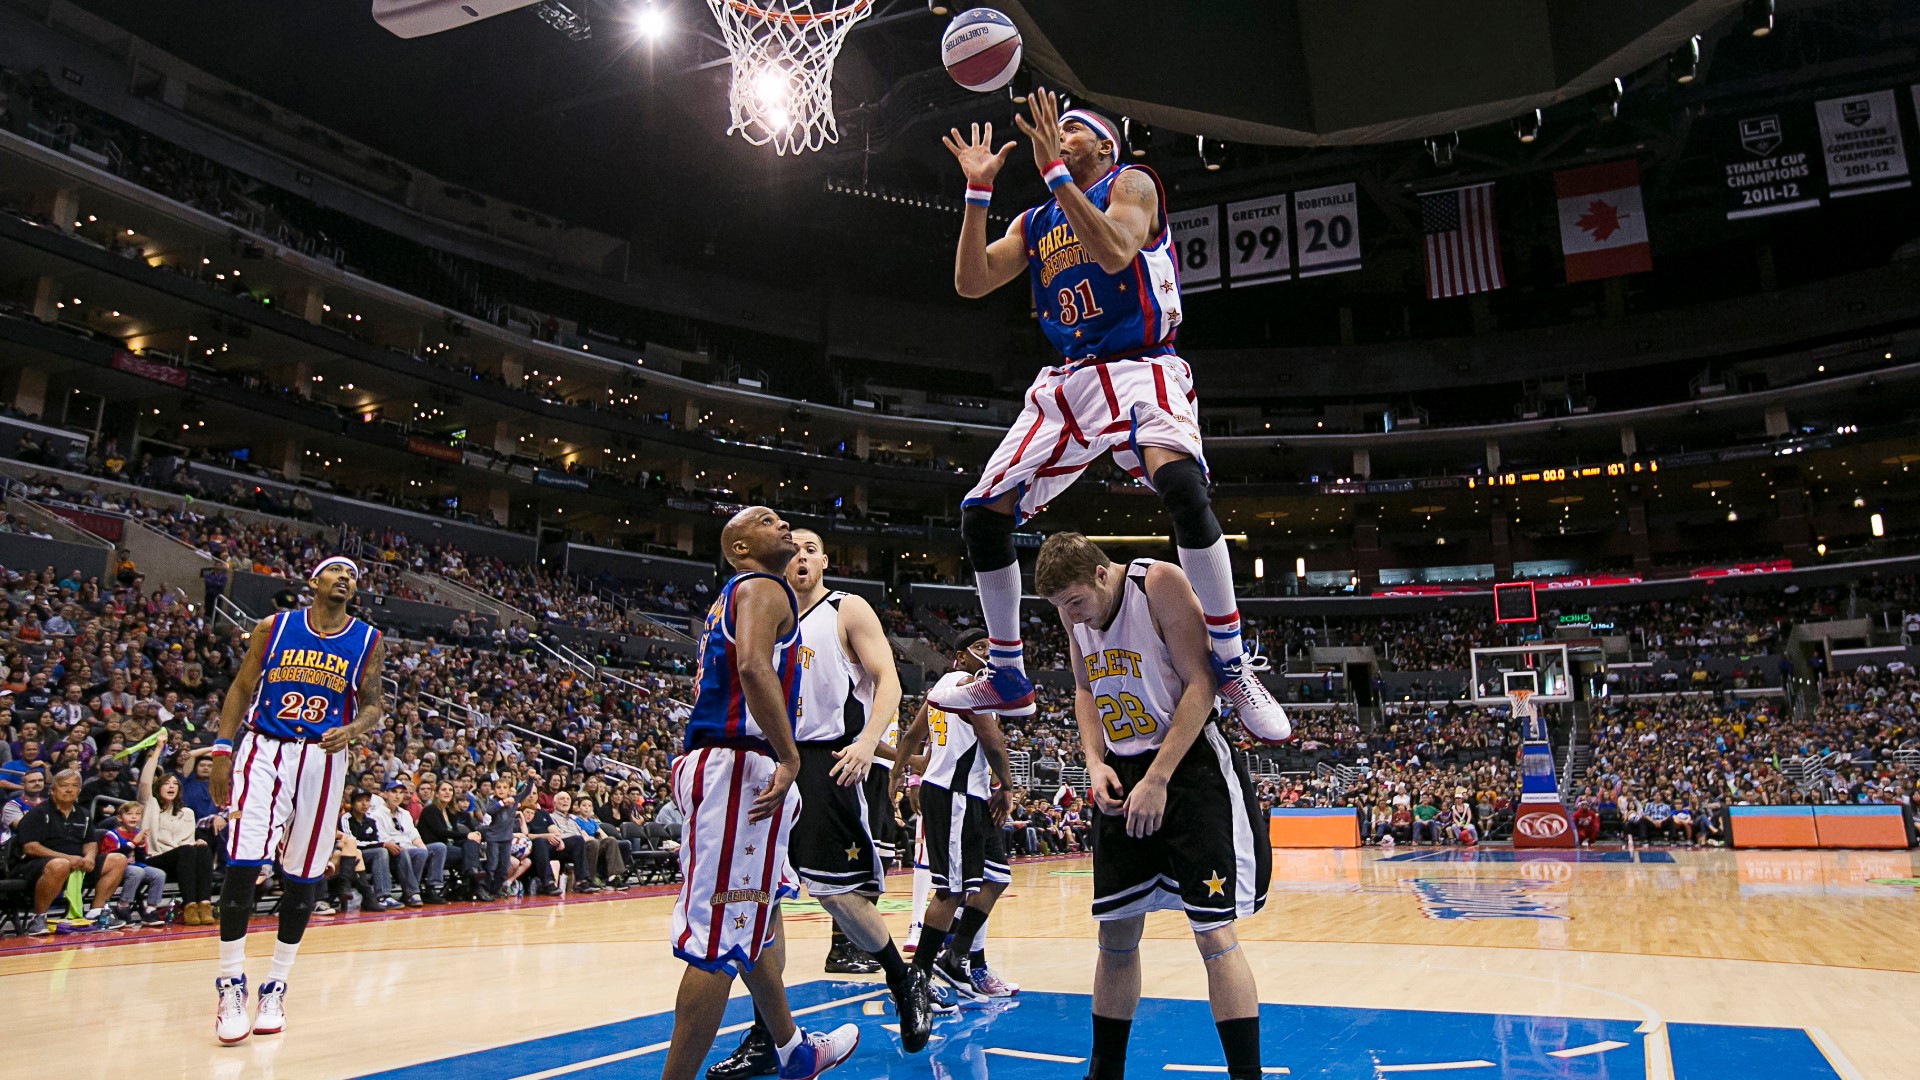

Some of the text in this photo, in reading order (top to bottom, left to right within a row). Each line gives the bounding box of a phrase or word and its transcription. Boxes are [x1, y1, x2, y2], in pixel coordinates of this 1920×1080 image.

[1828, 136, 1897, 153] CONFERENCE
[1835, 127, 1887, 142] WESTERN
[1726, 153, 1807, 176] STANLEY CUP
[1833, 147, 1897, 164] CHAMPIONS
[1727, 164, 1809, 188] CHAMPIONS
[1844, 161, 1890, 177] 2011-12
[1297, 192, 1354, 211] ROBITAILLE
[1742, 182, 1800, 205] 2011-12
[1170, 216, 1209, 232] TAYLOR
[1232, 204, 1282, 222] GRETZKY
[1038, 223, 1080, 262] HARL
[1235, 225, 1282, 264] 99
[1304, 214, 1353, 254] 20
[1058, 278, 1104, 325] 31
[280, 649, 350, 677] HARLEM
[1084, 648, 1143, 683] ELECT
[276, 691, 329, 724] 23
[1095, 691, 1158, 743] 28
